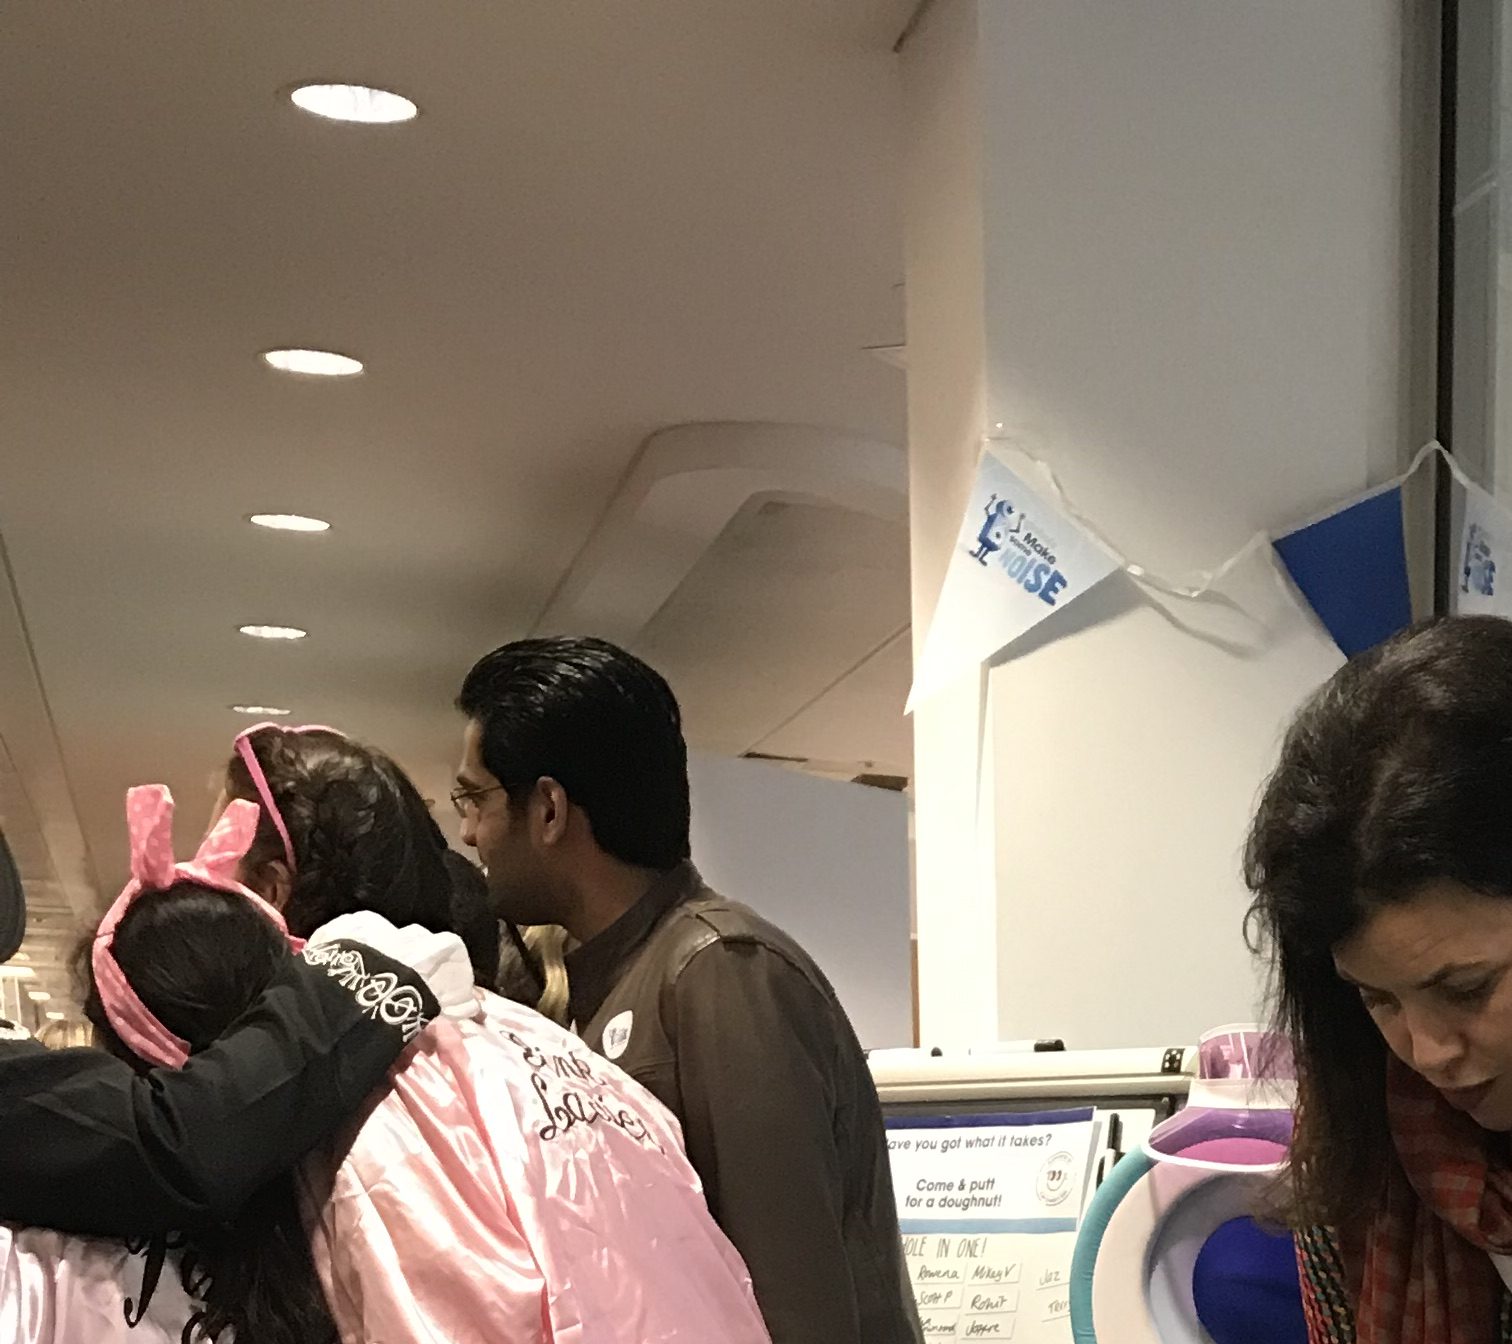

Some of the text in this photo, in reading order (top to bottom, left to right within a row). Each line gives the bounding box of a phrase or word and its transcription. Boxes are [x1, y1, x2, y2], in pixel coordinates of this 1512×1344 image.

[1023, 532, 1056, 565] Make
[1000, 547, 1068, 606] NOISE
[915, 1138, 938, 1152] you
[940, 1137, 962, 1153] got
[965, 1136, 995, 1149] what
[998, 1134, 1006, 1147] it
[1009, 1133, 1053, 1147] takes?
[916, 1178, 996, 1193] Come & putt
[905, 1195, 1003, 1210] for a doughnut!
[937, 1237, 951, 1259] IN
[957, 1237, 988, 1258] ONE!
